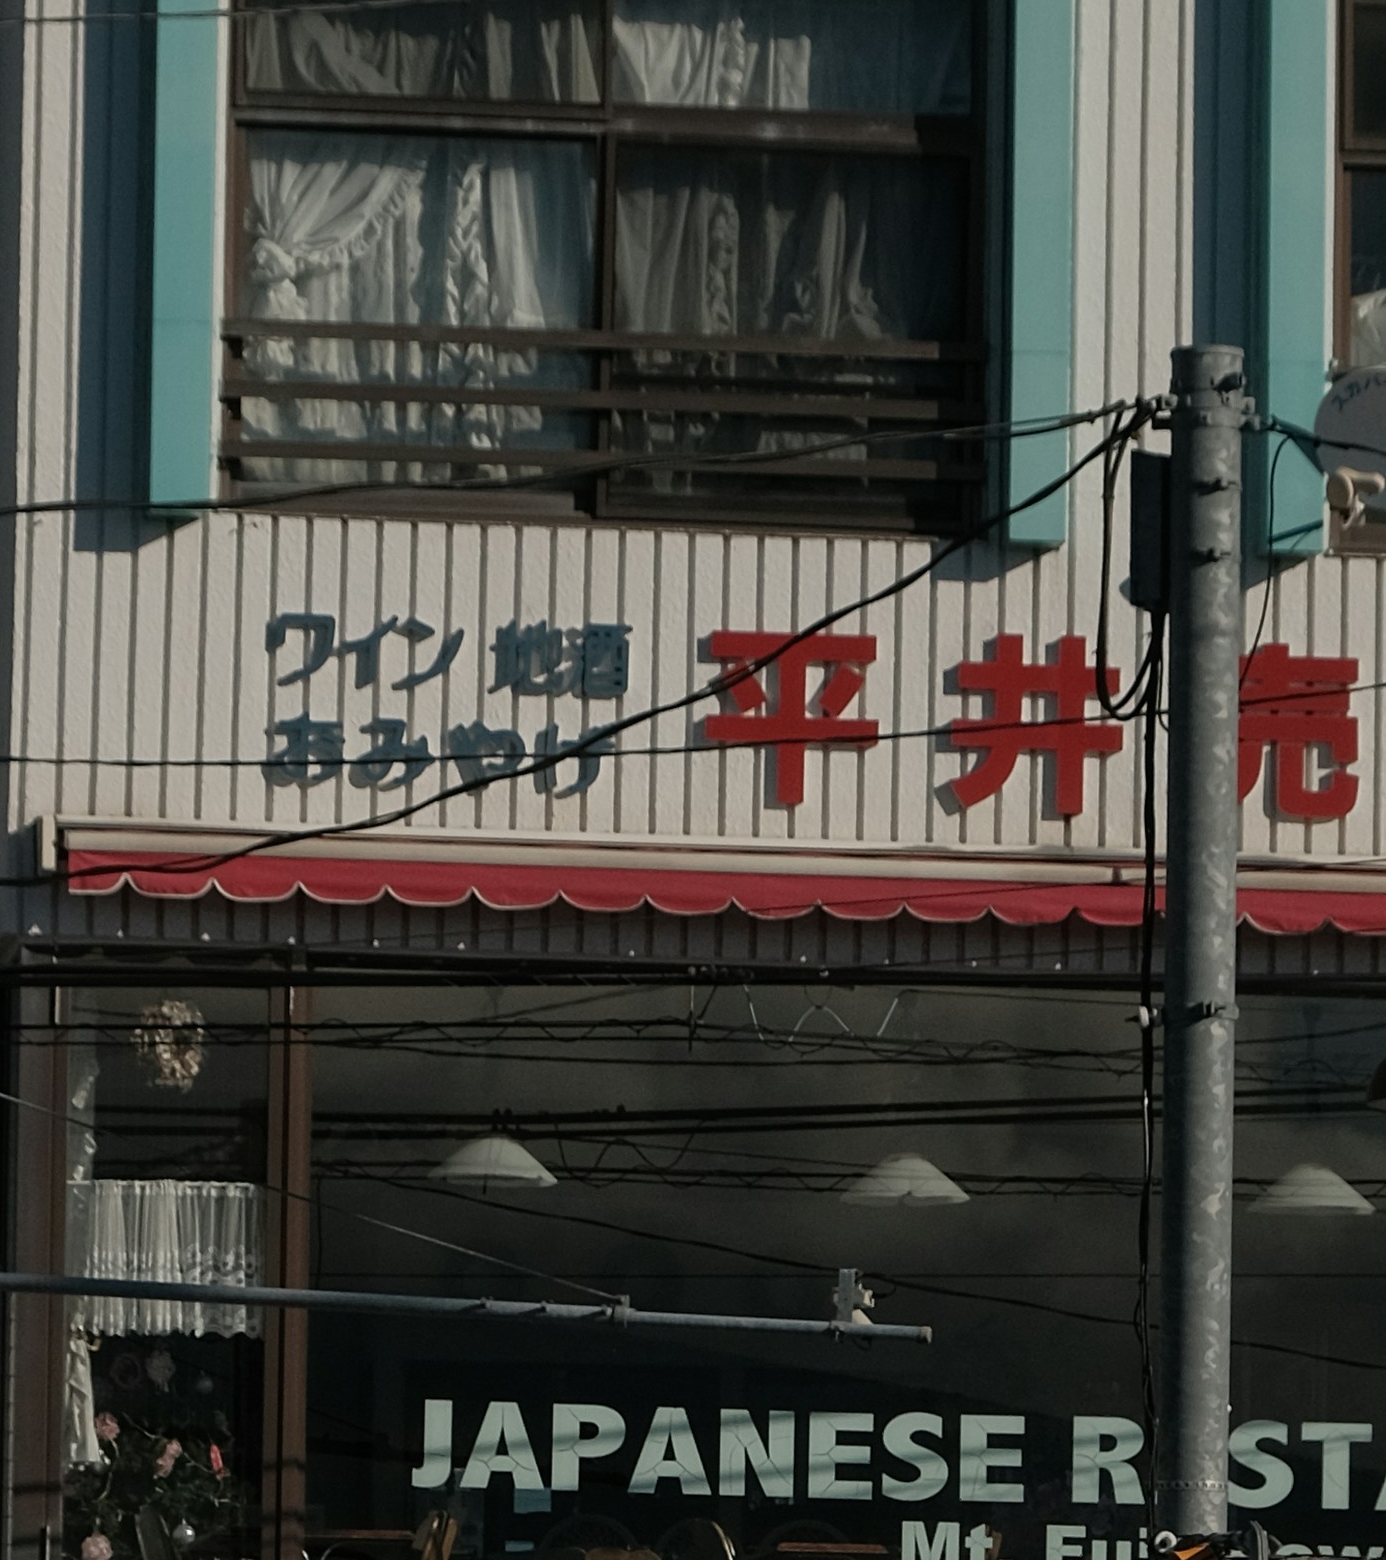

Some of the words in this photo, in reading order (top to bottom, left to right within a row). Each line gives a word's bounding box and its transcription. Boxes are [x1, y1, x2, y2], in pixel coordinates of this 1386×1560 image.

[265, 613, 464, 691] ワイン
[487, 620, 633, 699] 地酒
[262, 712, 616, 799] おみやげ
[412, 1397, 1026, 1504] JAPANESE
